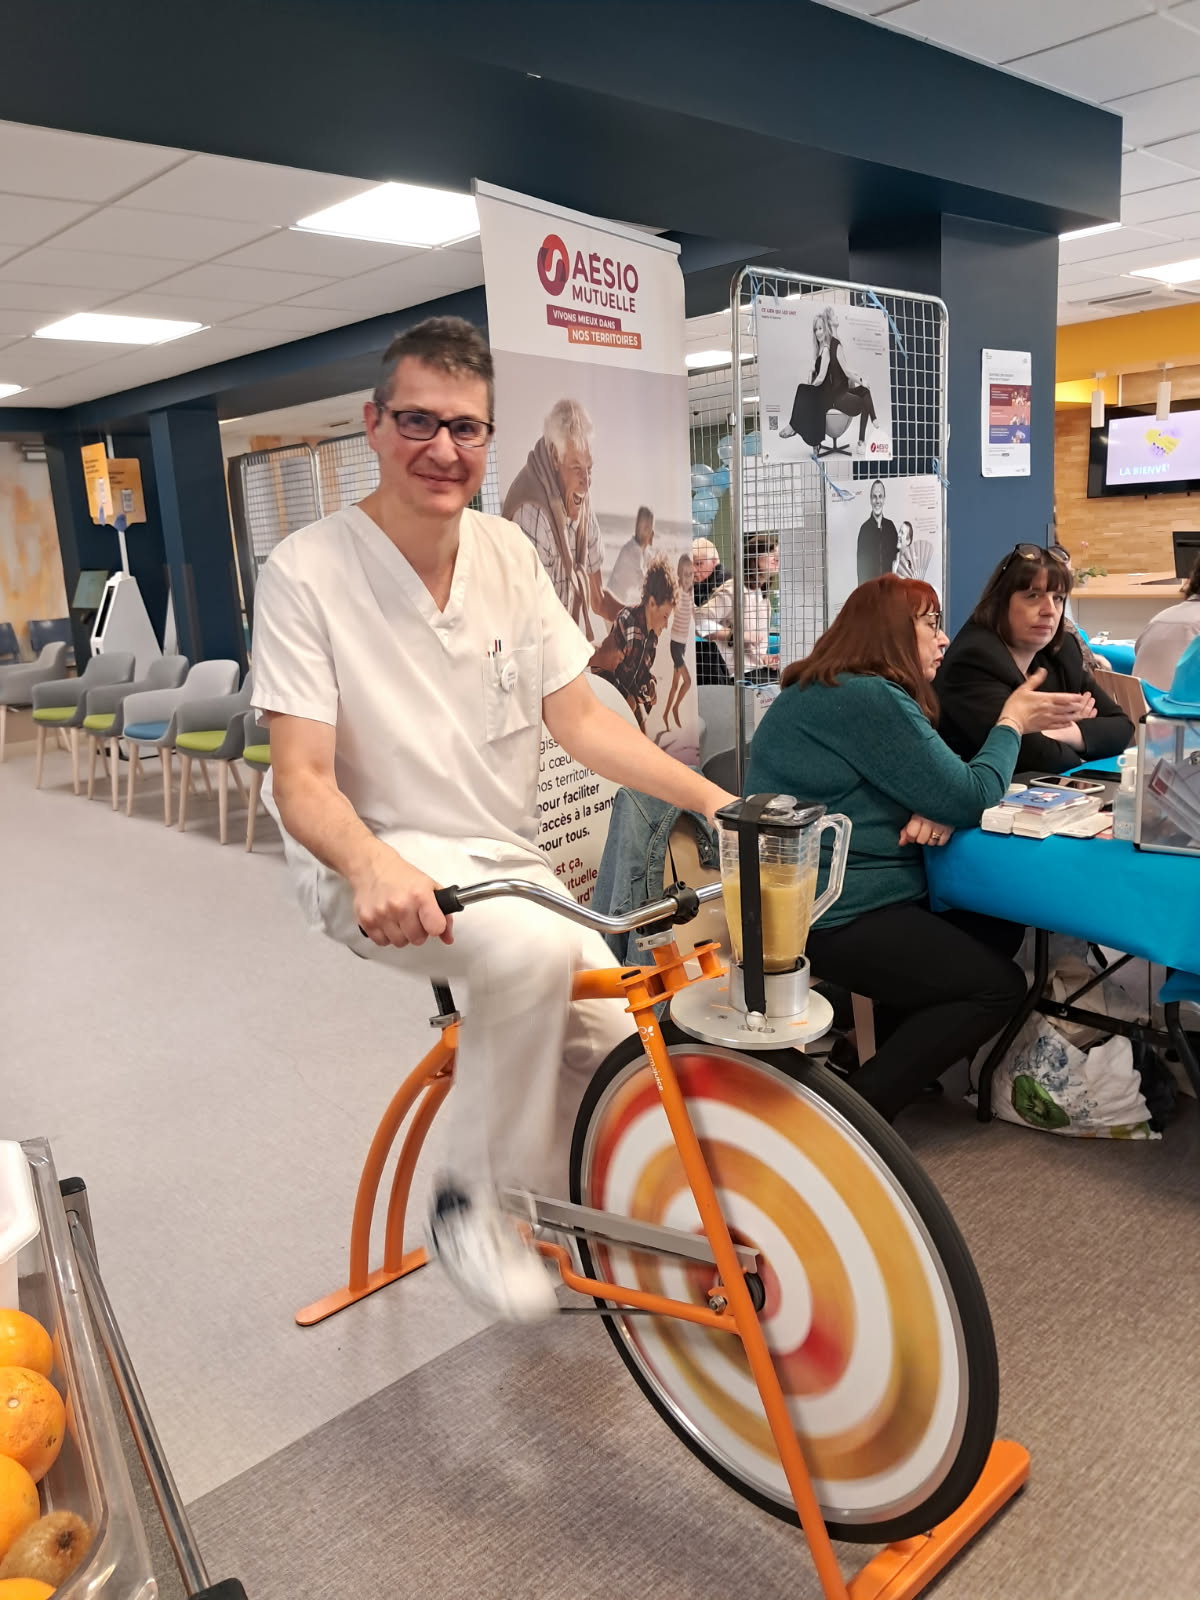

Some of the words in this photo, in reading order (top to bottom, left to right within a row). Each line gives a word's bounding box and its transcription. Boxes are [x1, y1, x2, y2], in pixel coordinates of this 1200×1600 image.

[572, 250, 638, 294] AÉSIO
[572, 285, 636, 313] MUTUELLE
[553, 309, 577, 322] VIVONS
[578, 314, 597, 326] MIEUX
[600, 318, 615, 329] DANS
[572, 330, 590, 341] NOS
[591, 332, 638, 346] TERRITOIRES
[1120, 467, 1131, 476] LA
[563, 784, 600, 805] faciliter
[575, 808, 580, 820] à
[583, 805, 591, 817] la
[566, 827, 590, 843] tous.
[554, 862, 566, 875] st
[569, 858, 583, 873] ça,
